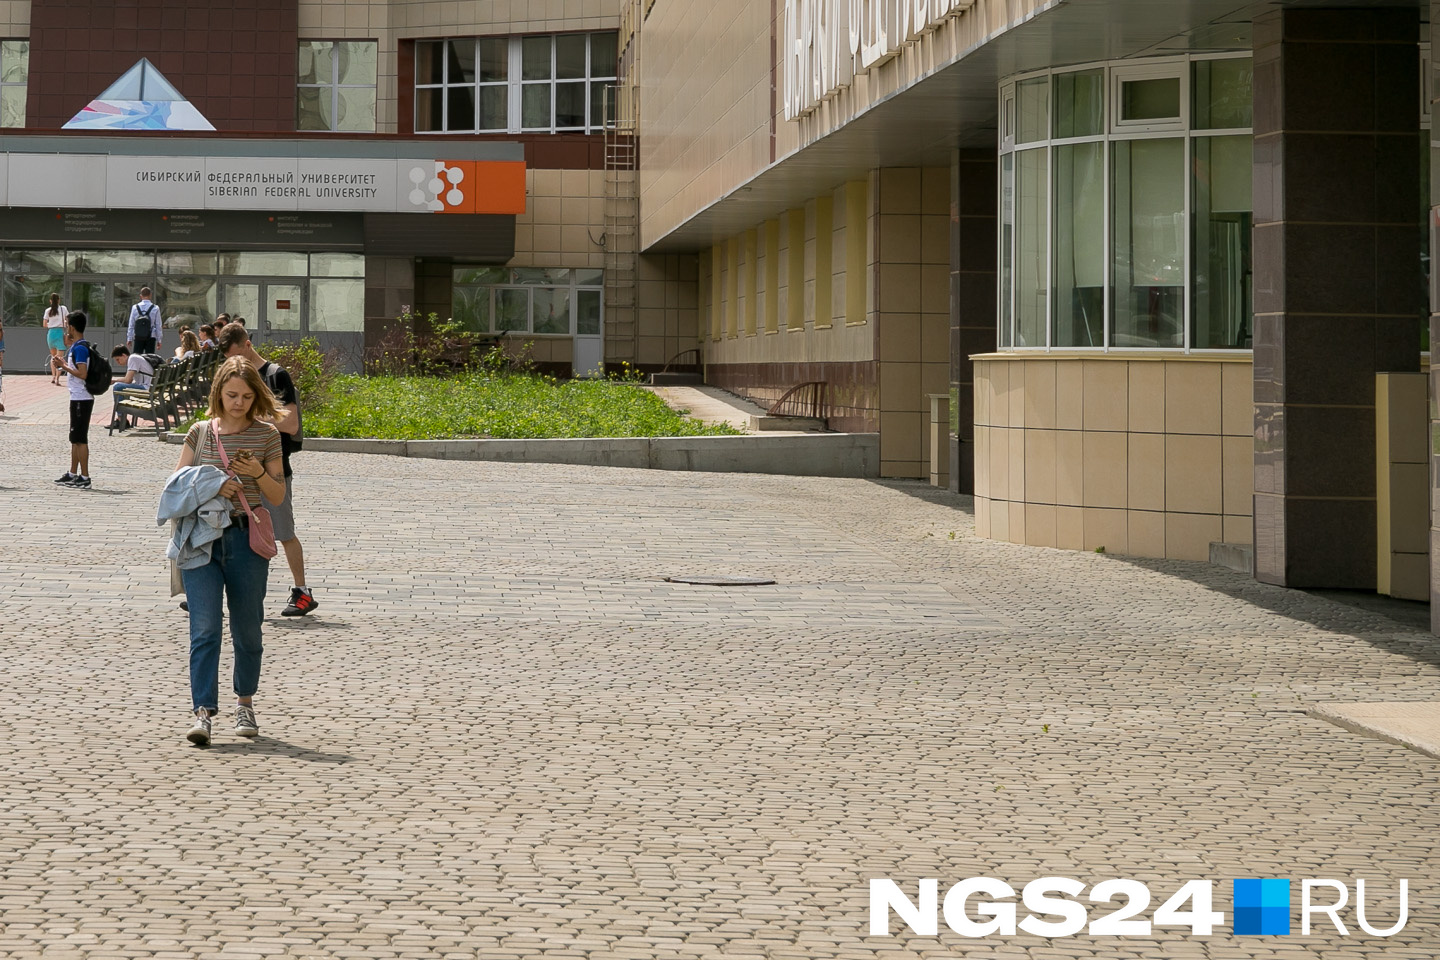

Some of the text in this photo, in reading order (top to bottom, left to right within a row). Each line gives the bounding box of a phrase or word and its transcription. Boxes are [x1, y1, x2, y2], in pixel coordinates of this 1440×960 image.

[136, 170, 376, 184] СИБИРСКИЙ ФЕДЕРАЛЬНЫЙ УНИВЕРСИТЕТ
[209, 186, 377, 198] SIBERIAN FEDERAL UNIVERSITY
